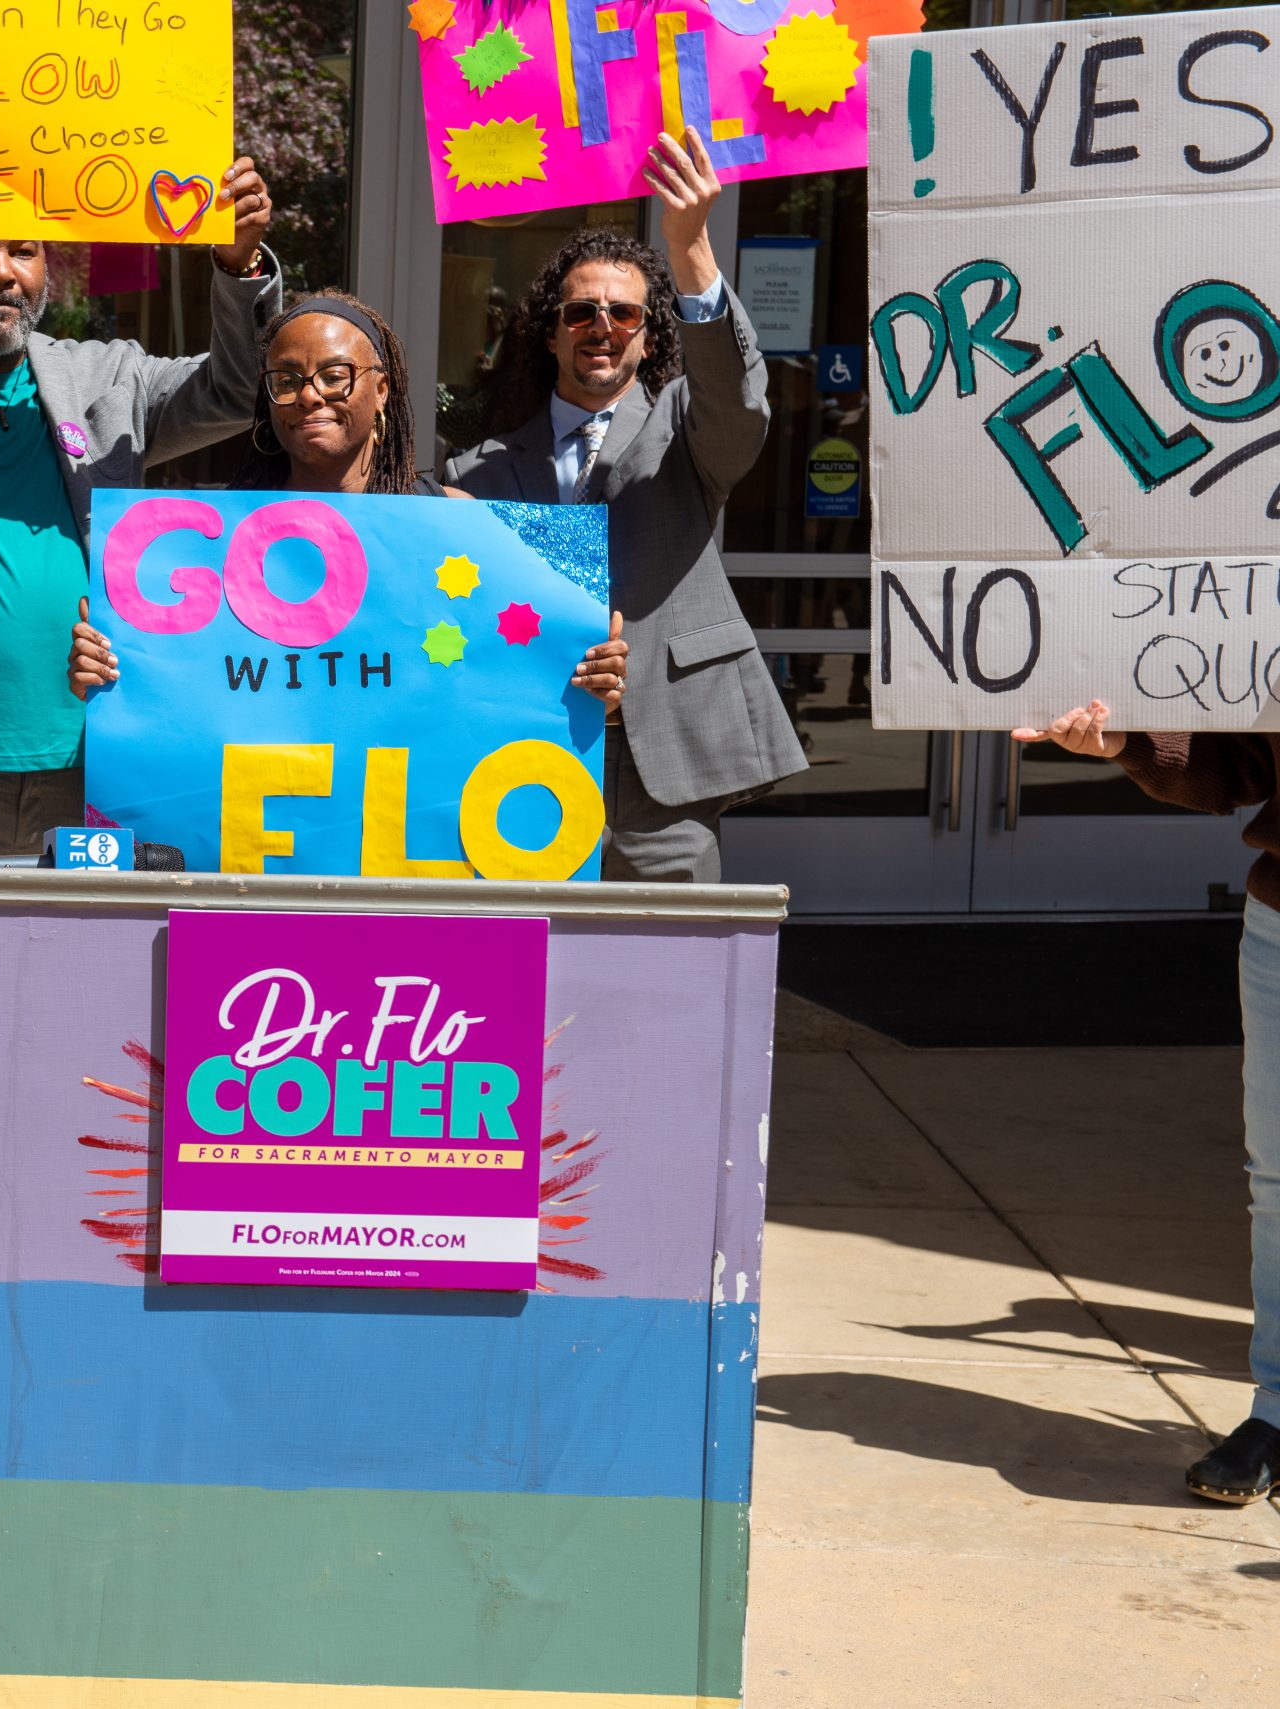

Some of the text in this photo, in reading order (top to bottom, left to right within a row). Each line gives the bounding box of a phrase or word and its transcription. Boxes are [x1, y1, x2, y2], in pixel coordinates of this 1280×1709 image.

[143, 1, 186, 31] Go
[549, 0, 796, 169] FL
[473, 130, 515, 145] MORE
[870, 257, 1064, 416] DR.
[982, 278, 1280, 558] FLO
[813, 462, 855, 471] CAUTION
[104, 497, 368, 648] GO
[224, 651, 391, 692] WITH
[881, 561, 1280, 694] NO STAT
[1133, 634, 1280, 711] QU
[220, 739, 605, 881] FLO
[219, 968, 486, 1067] Dr. Flo
[187, 1055, 520, 1140] COFER
[198, 1147, 505, 1165] FOR SACRAMENTO MAYOR
